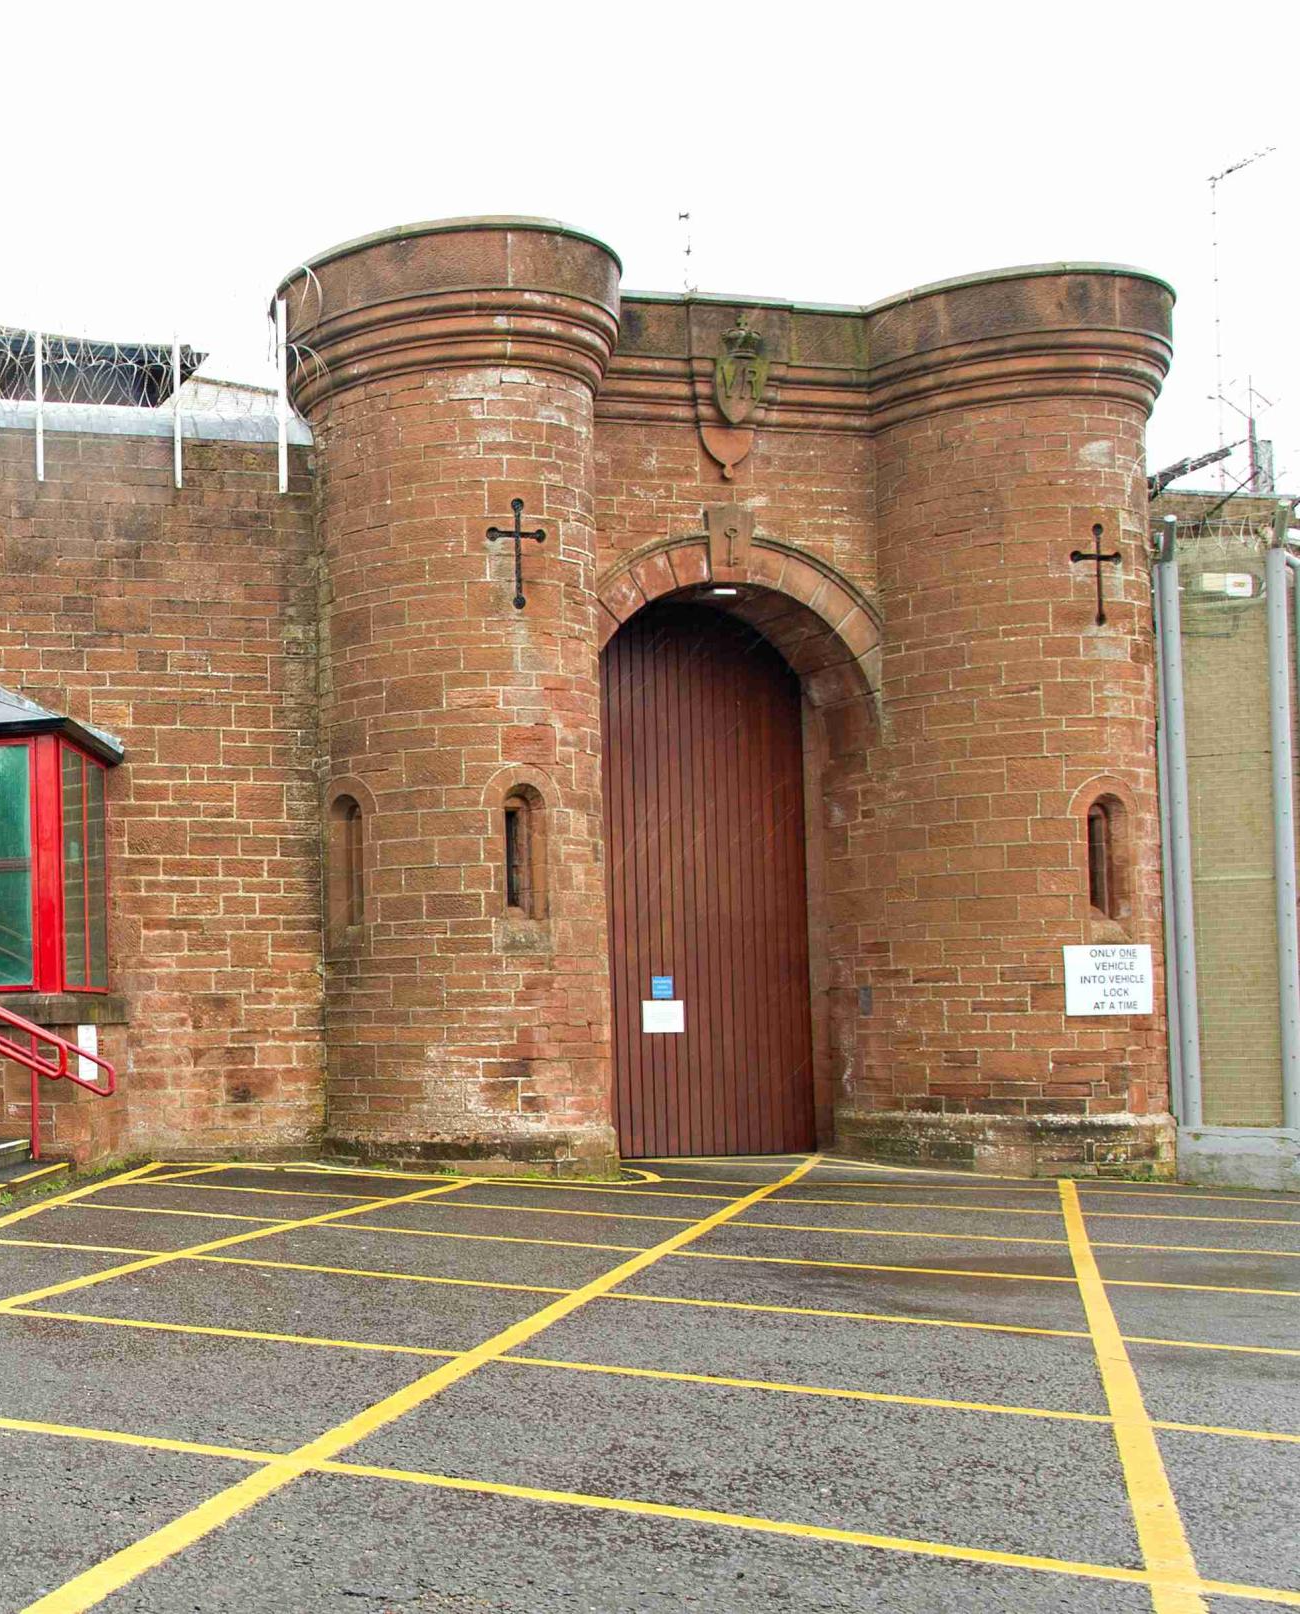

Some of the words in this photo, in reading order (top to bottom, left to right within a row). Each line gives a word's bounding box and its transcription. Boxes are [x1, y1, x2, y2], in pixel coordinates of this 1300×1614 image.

[721, 365, 759, 399] VR
[1089, 948, 1116, 958] ONLY
[1119, 948, 1138, 959] ONE
[1094, 961, 1135, 971] VEHICLE
[1080, 975, 1106, 984] INTO
[1109, 974, 1145, 984] VEHICLE
[1103, 988, 1130, 997] LOCK
[1093, 1001, 1106, 1010] AT
[1109, 1001, 1116, 1010] A
[1118, 1000, 1139, 1010] TIME
